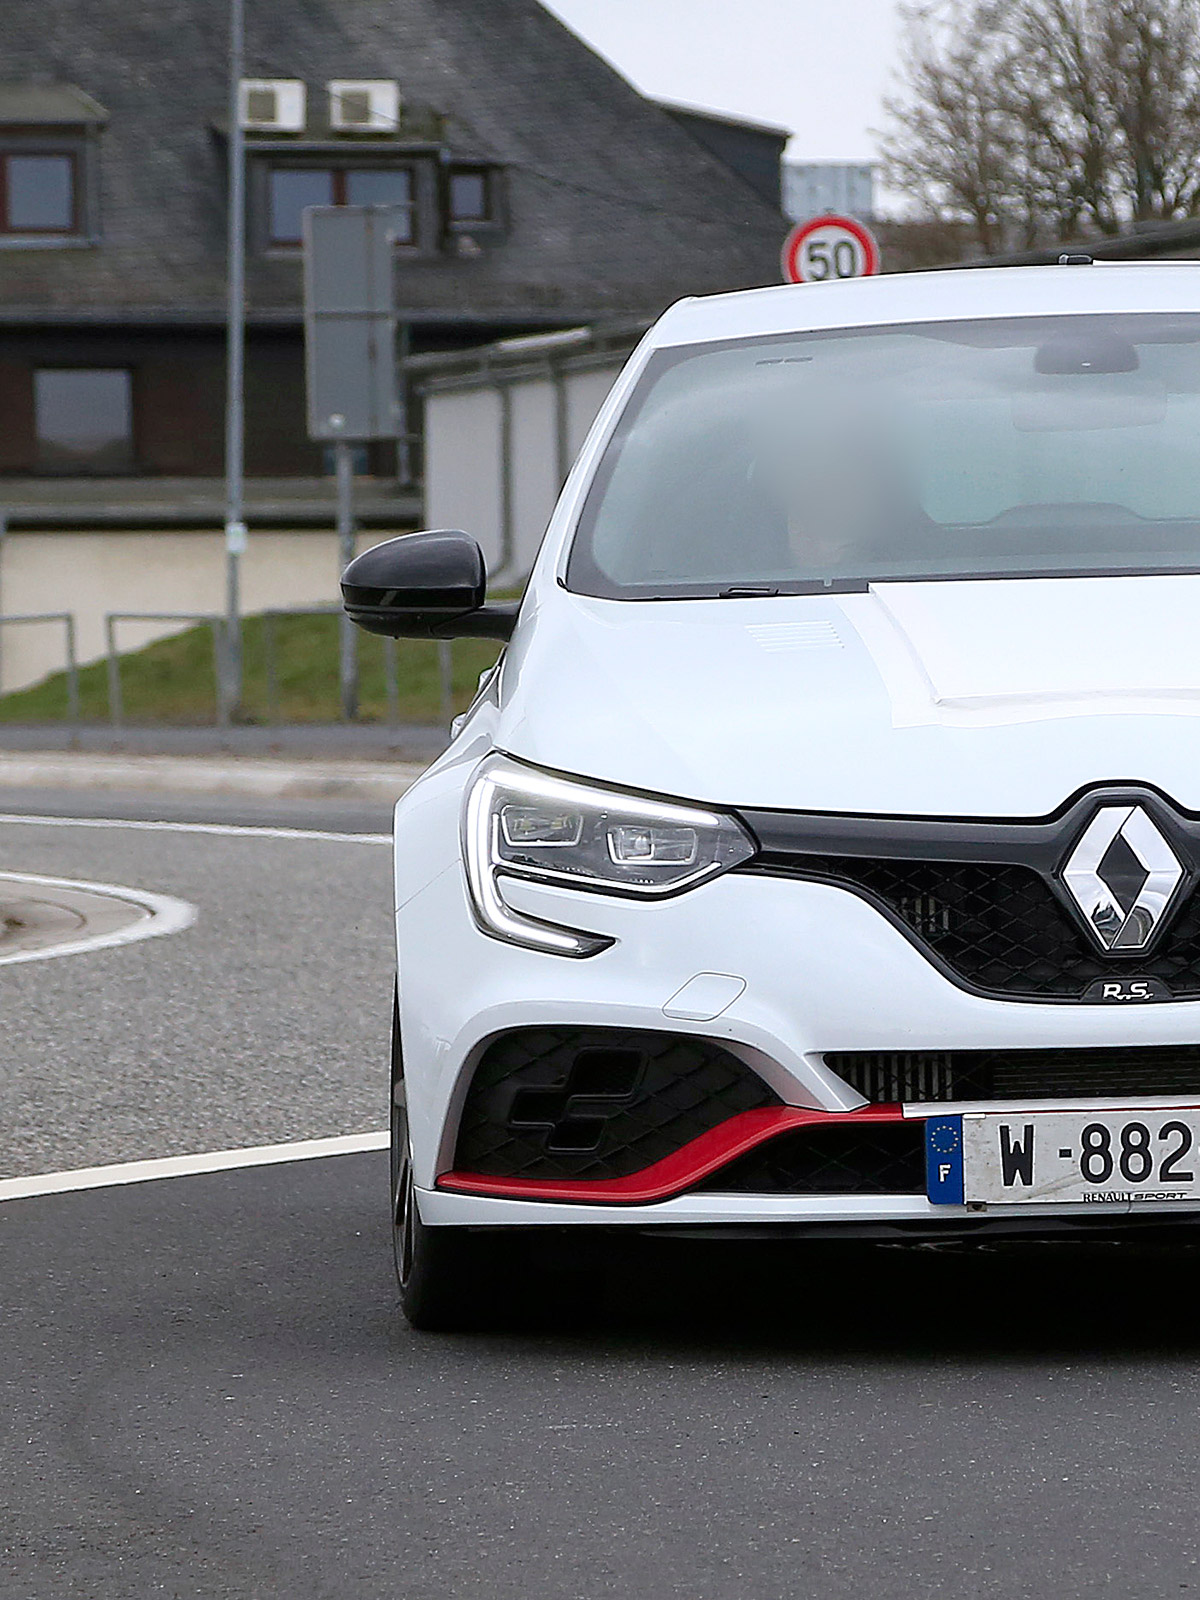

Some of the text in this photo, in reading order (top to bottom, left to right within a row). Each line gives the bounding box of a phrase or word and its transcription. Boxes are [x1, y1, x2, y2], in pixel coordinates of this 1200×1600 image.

[808, 241, 856, 281] 50
[939, 1164, 951, 1182] F
[1083, 1191, 1188, 1203] RENAULT SPORT
